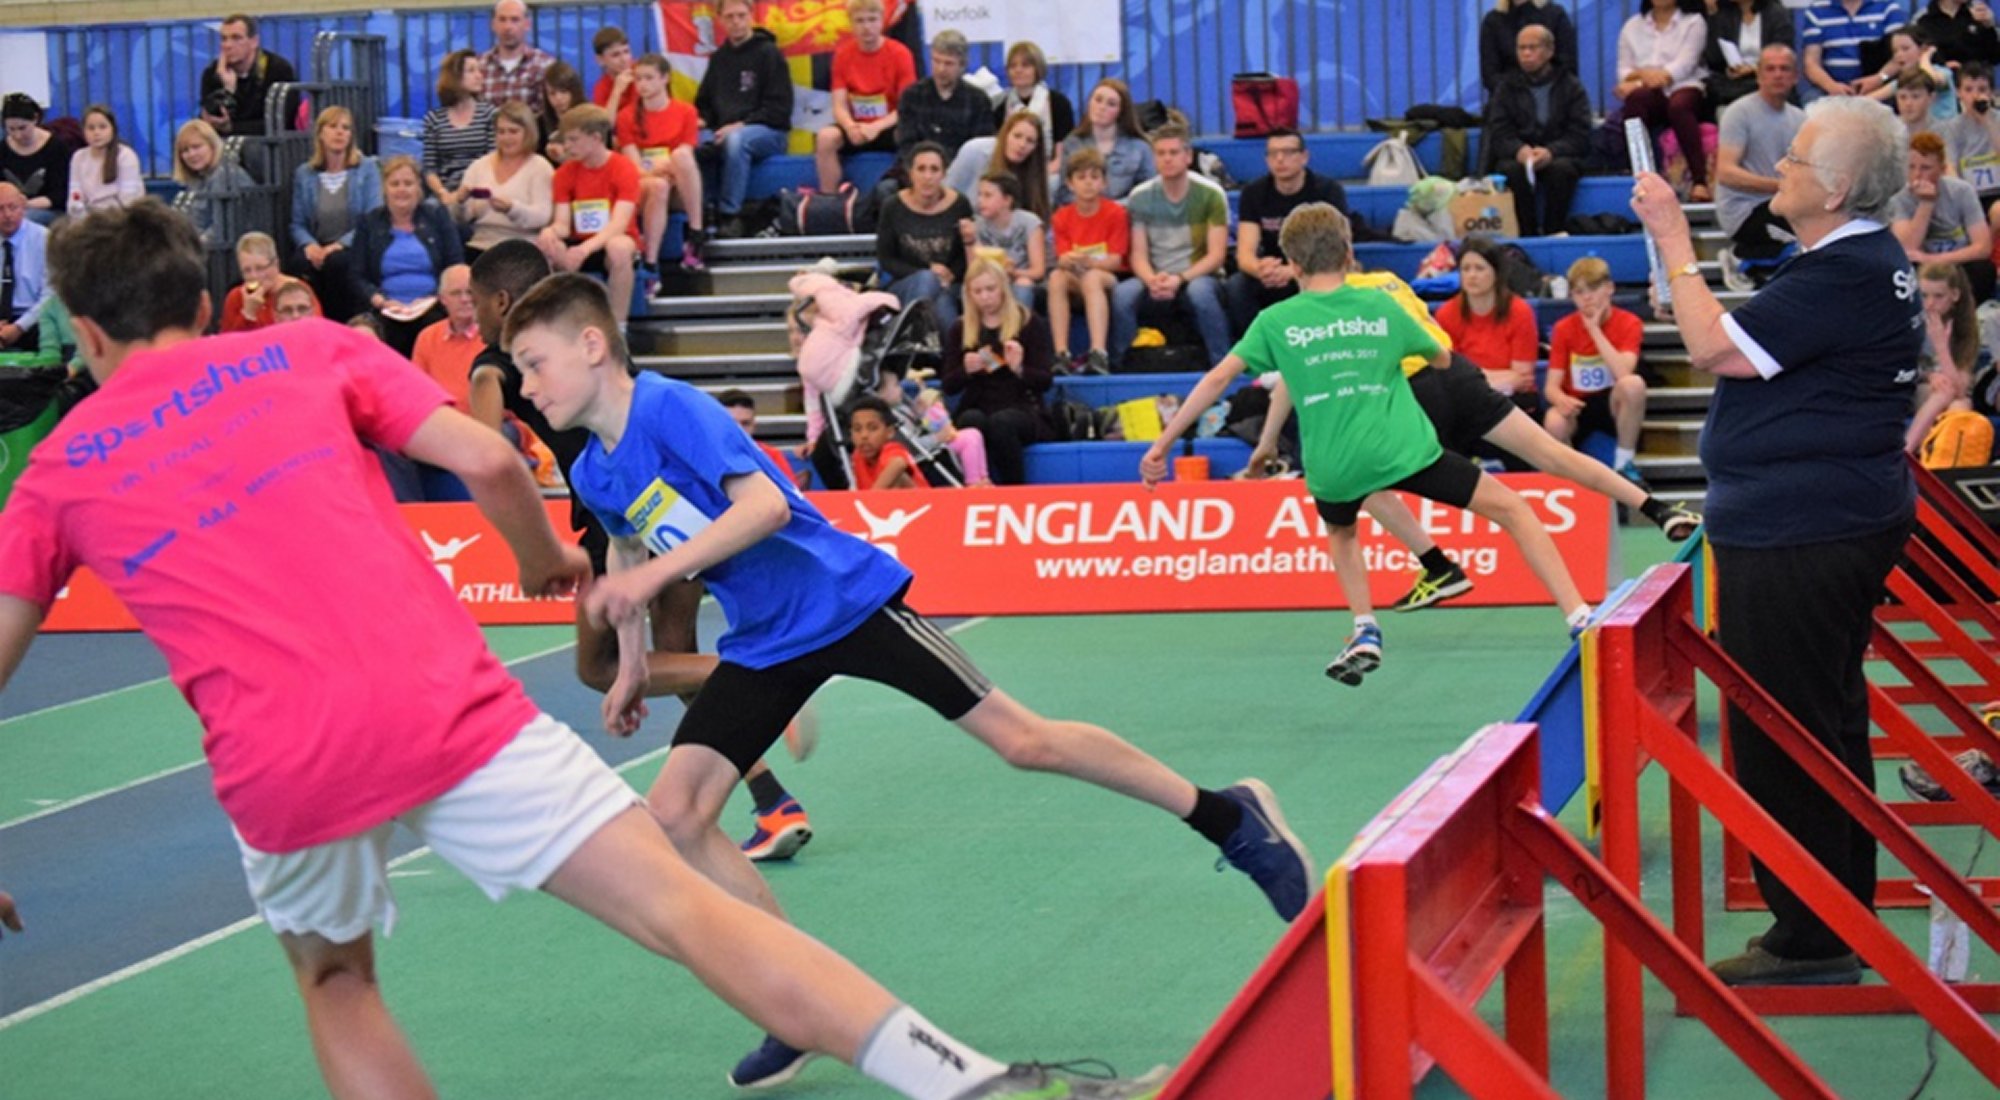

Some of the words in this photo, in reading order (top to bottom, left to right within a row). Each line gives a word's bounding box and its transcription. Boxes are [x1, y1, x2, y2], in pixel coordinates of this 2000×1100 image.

[934, 7, 990, 21] Norfolk
[1973, 167, 1994, 186] 71
[1463, 216, 1503, 231] one
[1285, 315, 1389, 348] Sportshall
[1322, 350, 1354, 362] FINAL
[1580, 367, 1605, 388] 89
[65, 343, 290, 469] Sportshall
[963, 498, 1236, 546] ENGLAND
[1035, 546, 1498, 582] www.englandathticsorg
[1574, 871, 1606, 902] 2
